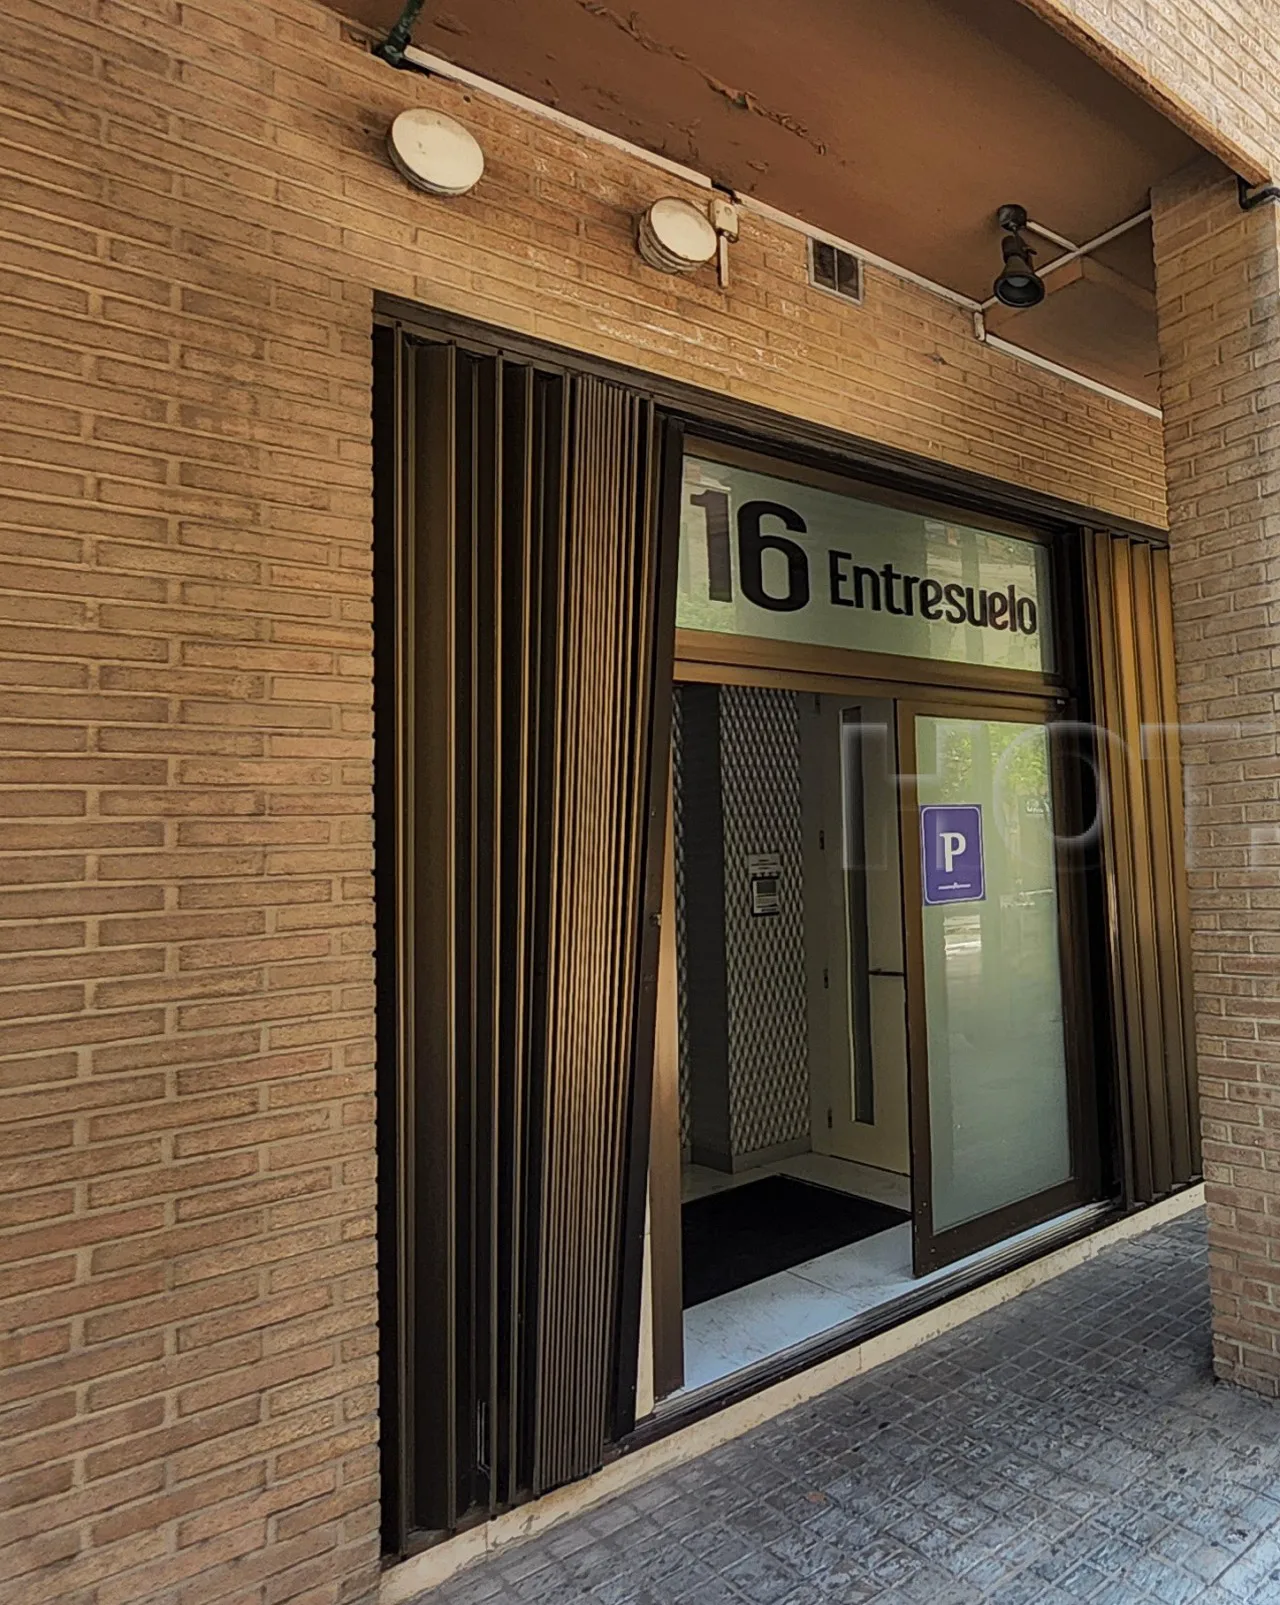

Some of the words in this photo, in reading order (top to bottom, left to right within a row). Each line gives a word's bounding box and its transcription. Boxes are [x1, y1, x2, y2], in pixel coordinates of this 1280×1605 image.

[690, 488, 811, 612] 16
[828, 549, 1037, 635] Entresuelo
[939, 832, 967, 873] P
